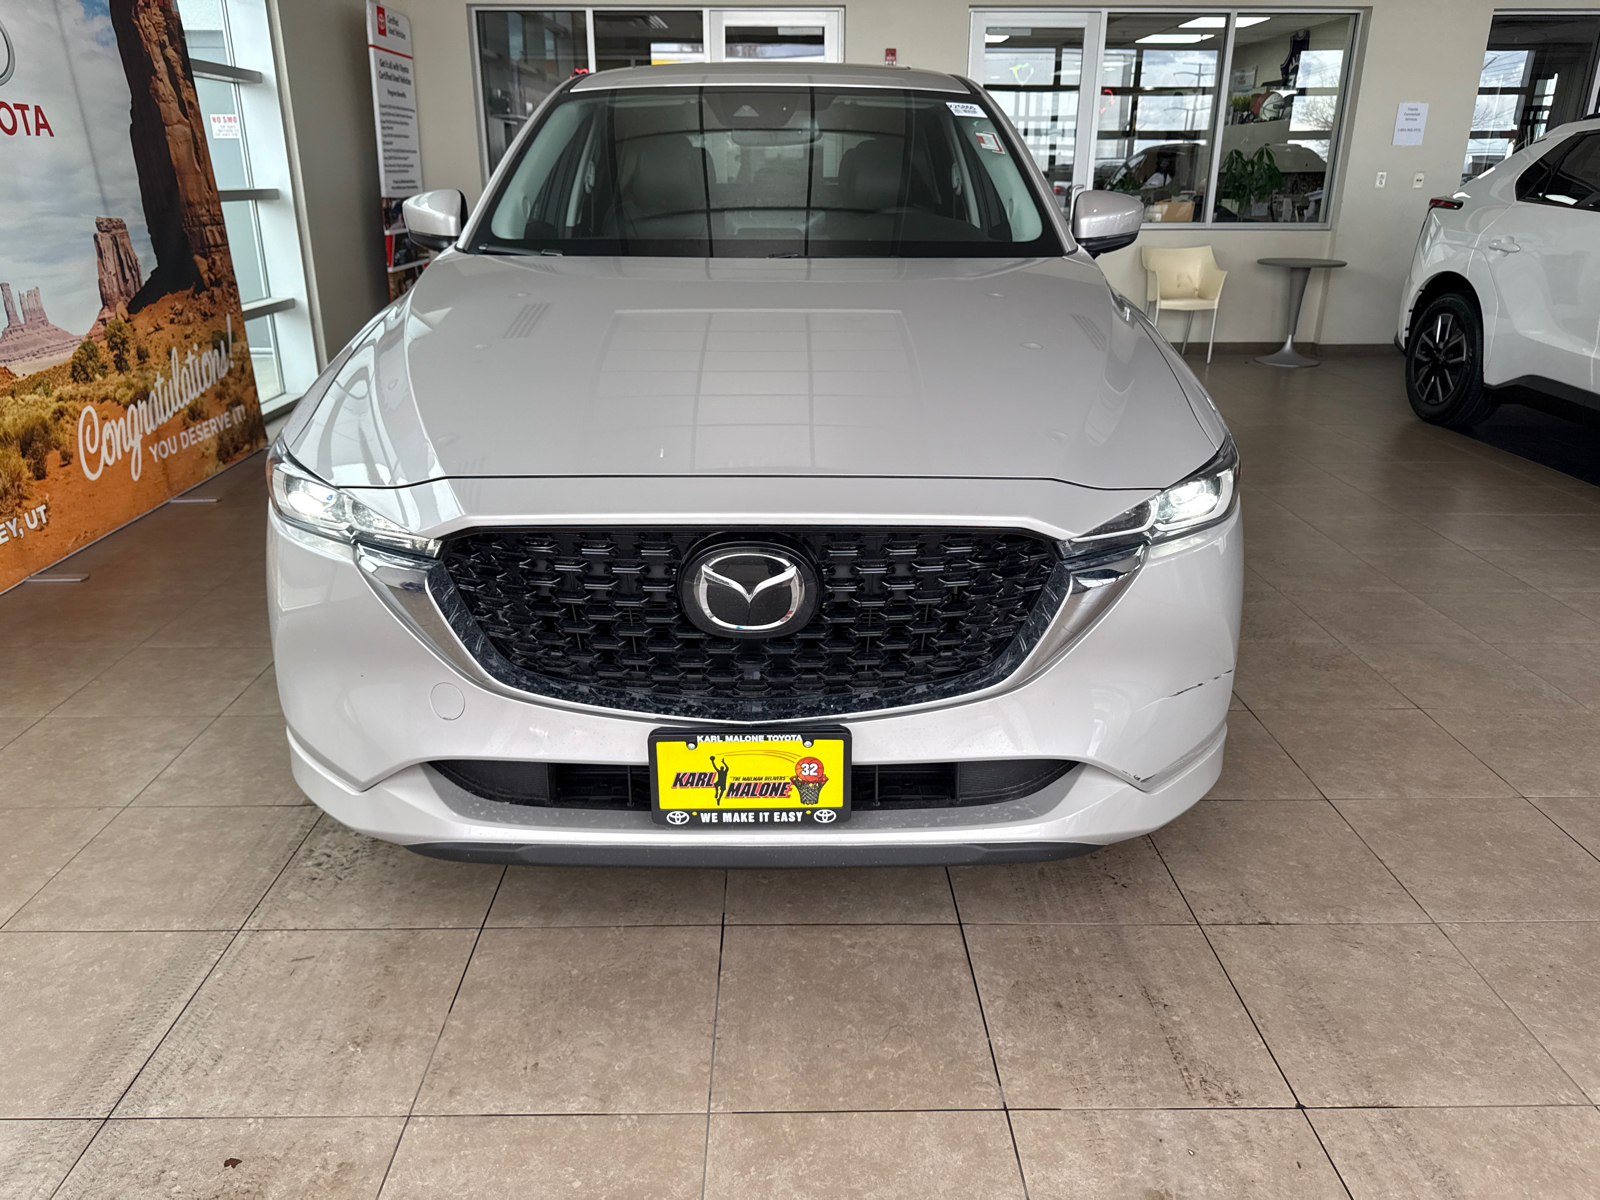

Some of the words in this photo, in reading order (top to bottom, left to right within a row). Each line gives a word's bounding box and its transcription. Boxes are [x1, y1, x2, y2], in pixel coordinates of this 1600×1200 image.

[78, 314, 234, 481] Congratulations!
[149, 433, 177, 463] YOU
[181, 411, 232, 450] DESERVE
[232, 404, 247, 426] IT!
[24, 504, 47, 529] UT
[697, 735, 721, 743] KARL
[767, 734, 802, 742] TOYOTA
[801, 763, 818, 776] 32
[672, 772, 716, 789] KARL
[725, 782, 792, 798] MALONE
[700, 813, 718, 823] WE
[723, 812, 755, 823] MAKE
[759, 812, 770, 822] IT
[773, 811, 803, 822] EASY
